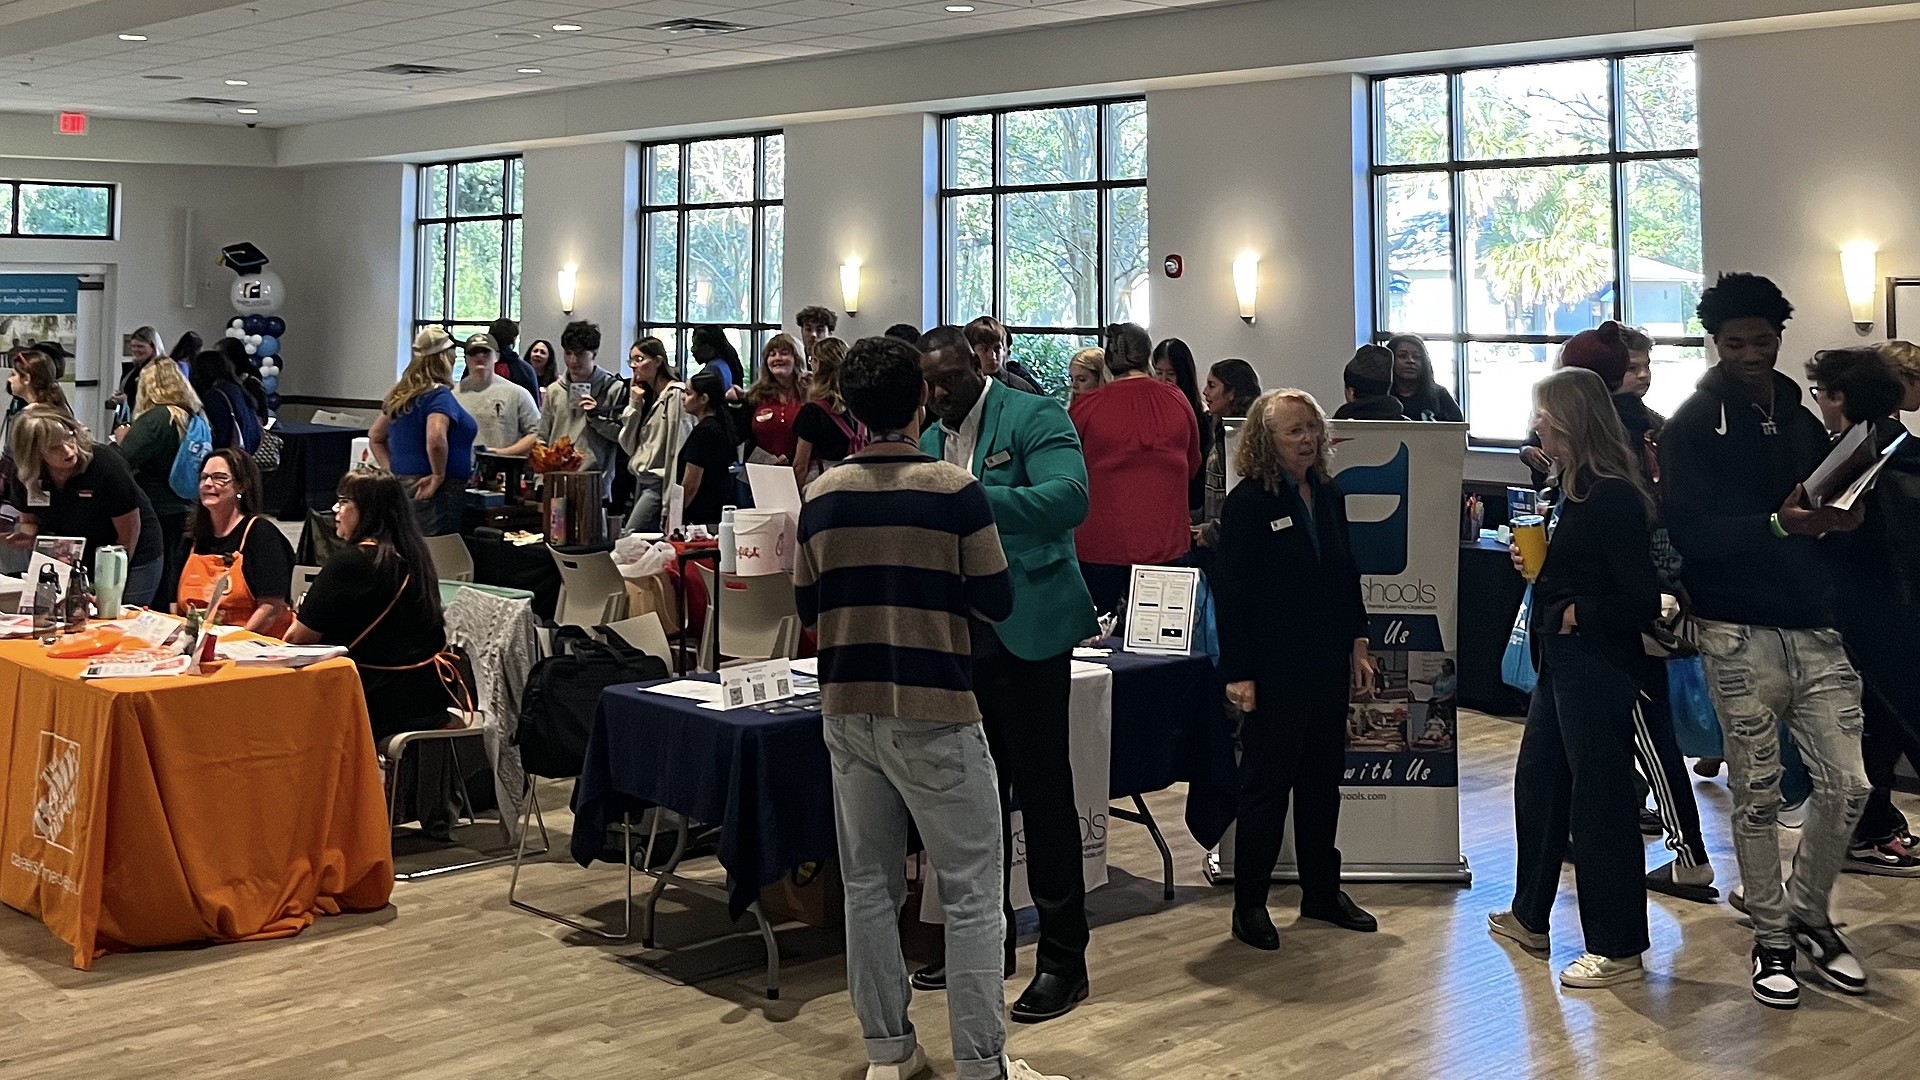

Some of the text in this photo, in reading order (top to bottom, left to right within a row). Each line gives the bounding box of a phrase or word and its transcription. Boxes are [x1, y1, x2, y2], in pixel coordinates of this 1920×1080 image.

[1384, 620, 1410, 644] Us
[1344, 758, 1431, 781] with Us
